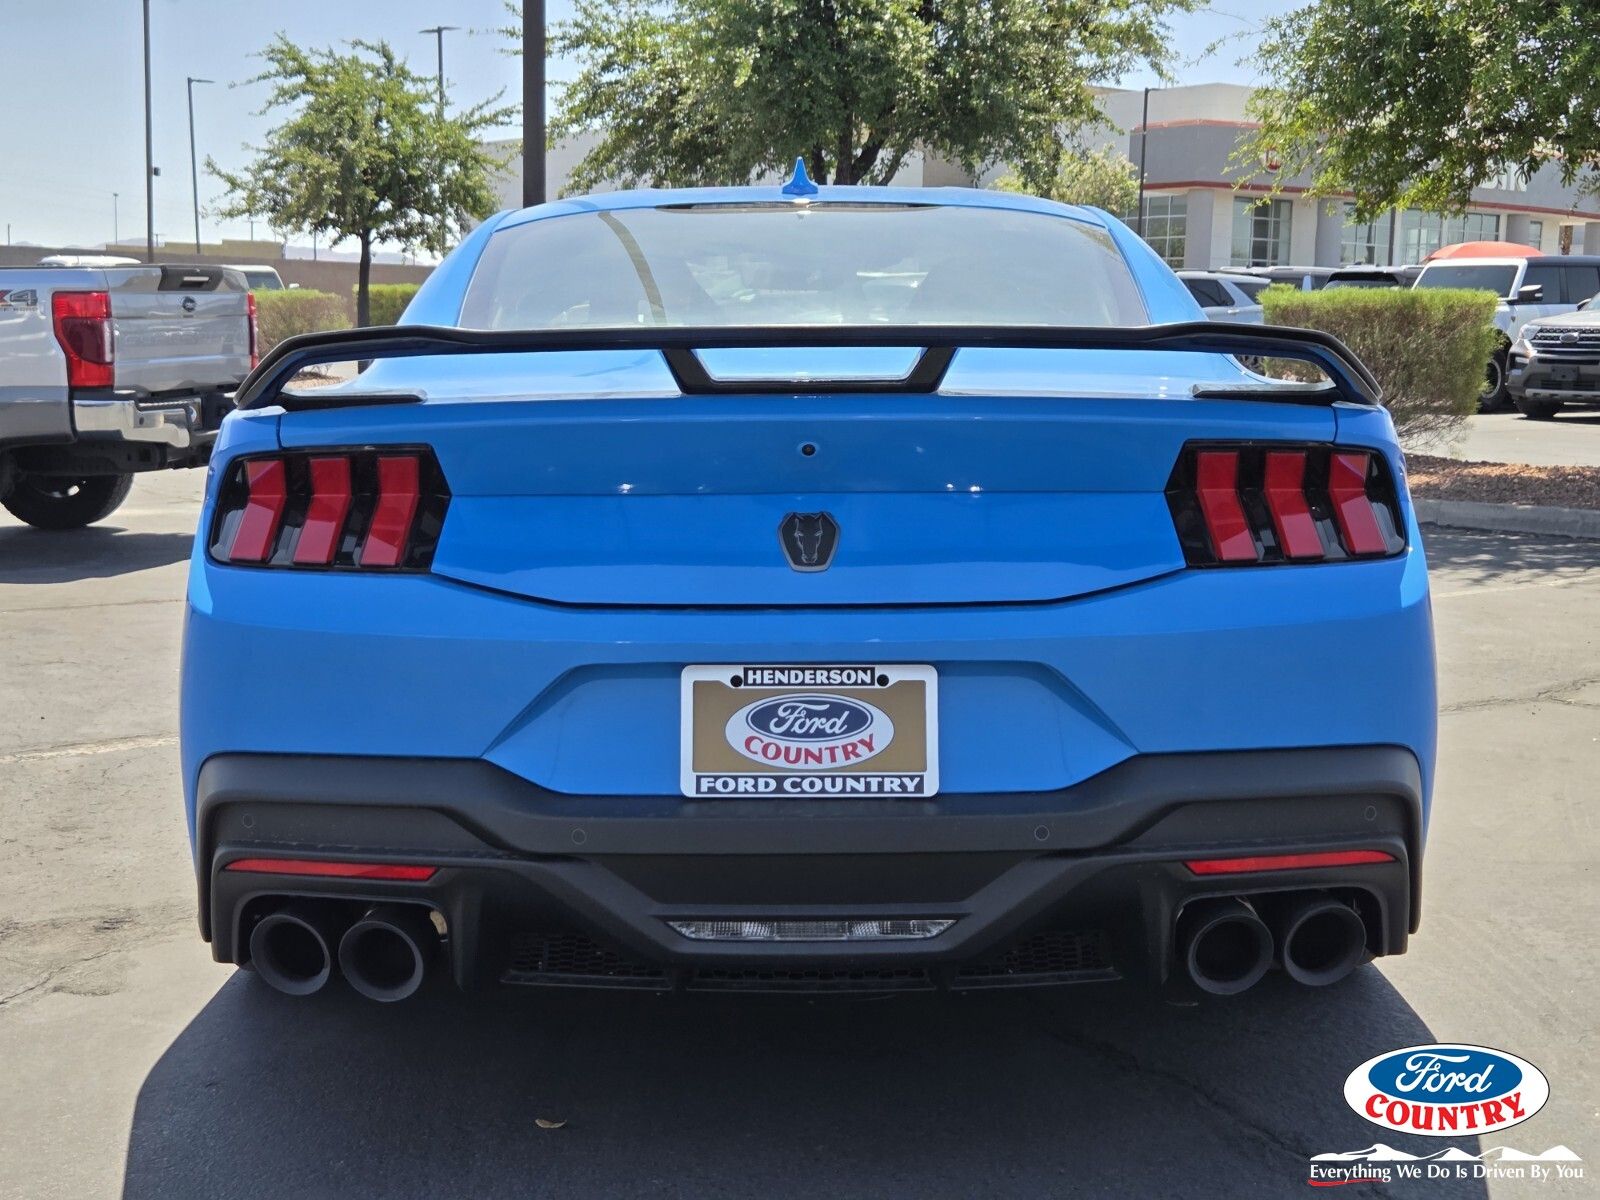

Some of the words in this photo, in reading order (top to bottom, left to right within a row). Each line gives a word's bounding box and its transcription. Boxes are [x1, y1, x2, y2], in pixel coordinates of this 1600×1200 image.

[747, 669, 872, 685] HENDERSON
[769, 701, 850, 735] Ford
[744, 733, 876, 765] COUNTRY
[700, 777, 777, 793] FORD
[783, 777, 921, 793] COUNTRY
